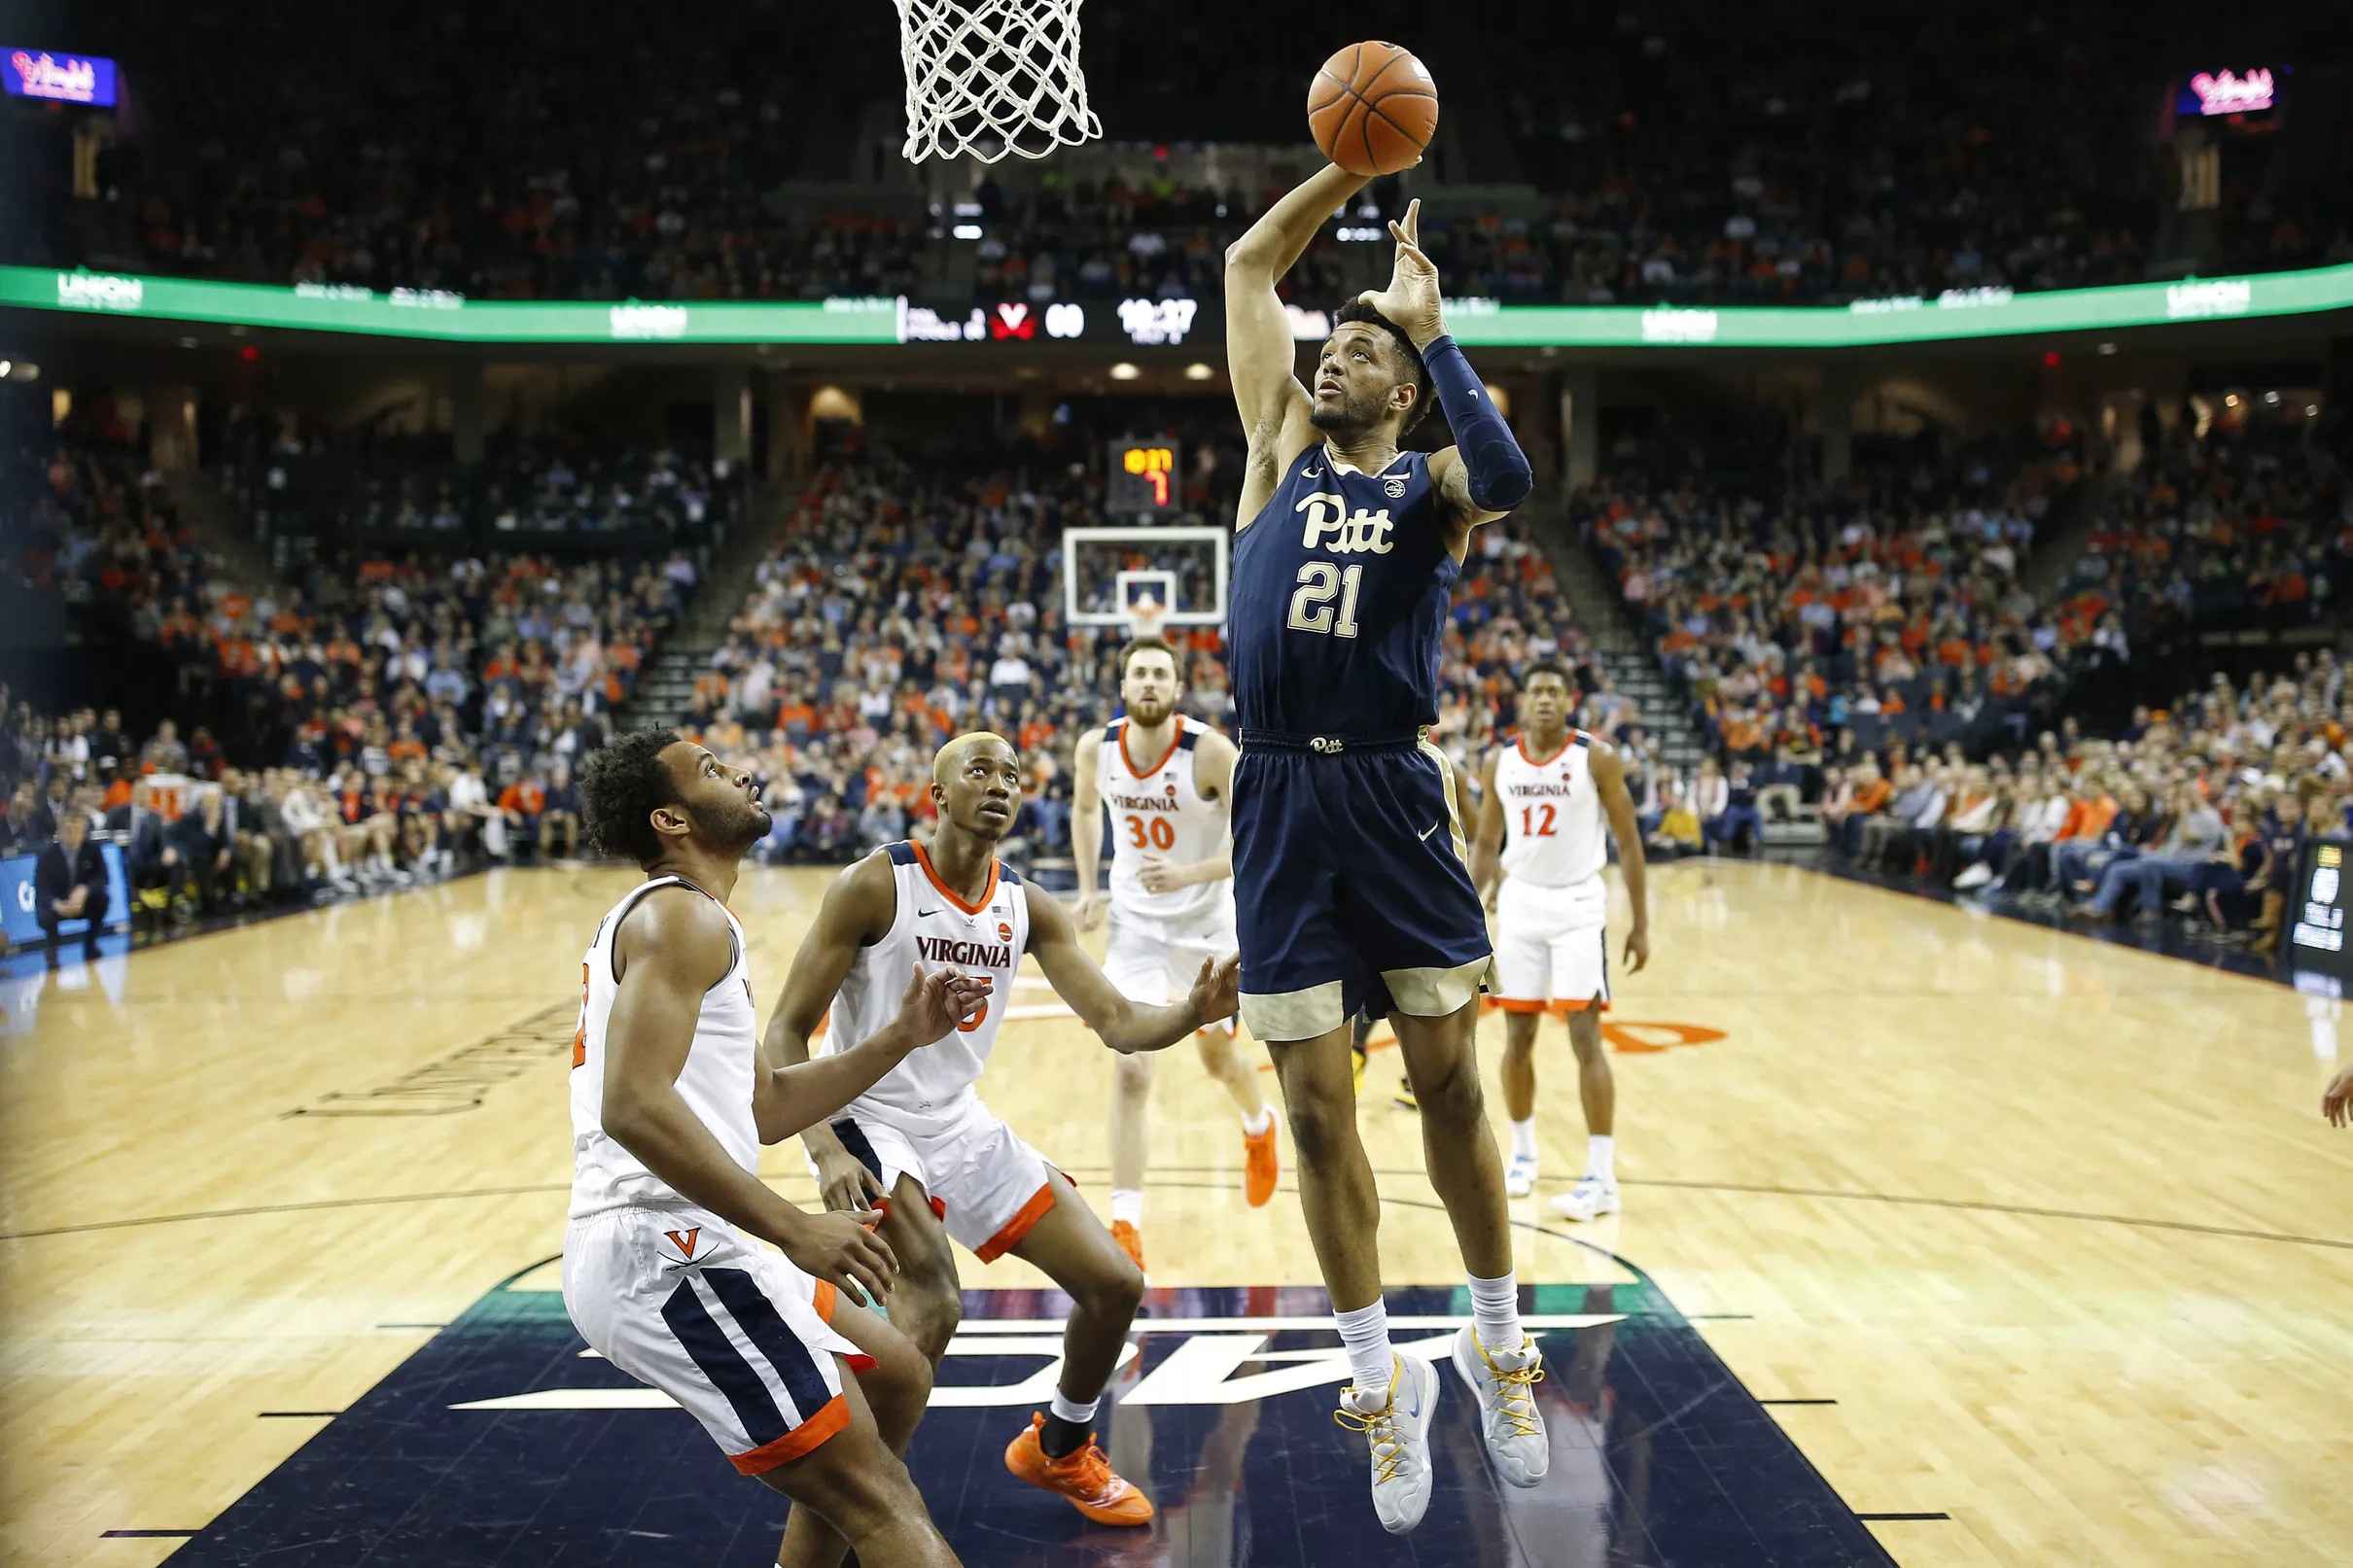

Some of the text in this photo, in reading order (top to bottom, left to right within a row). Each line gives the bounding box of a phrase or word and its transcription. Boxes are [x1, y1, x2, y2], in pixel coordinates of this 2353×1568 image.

[1295, 491, 1394, 554] Pitt
[1287, 561, 1362, 638] 21
[1310, 737, 1344, 754] Pitt
[1110, 793, 1179, 811] VIRGINIA
[1507, 784, 1571, 796] VIRGINIA
[1125, 816, 1175, 850] 30
[1522, 804, 1558, 837] 12
[916, 936, 1011, 968] VIRGINIA
[663, 1227, 702, 1260] V
